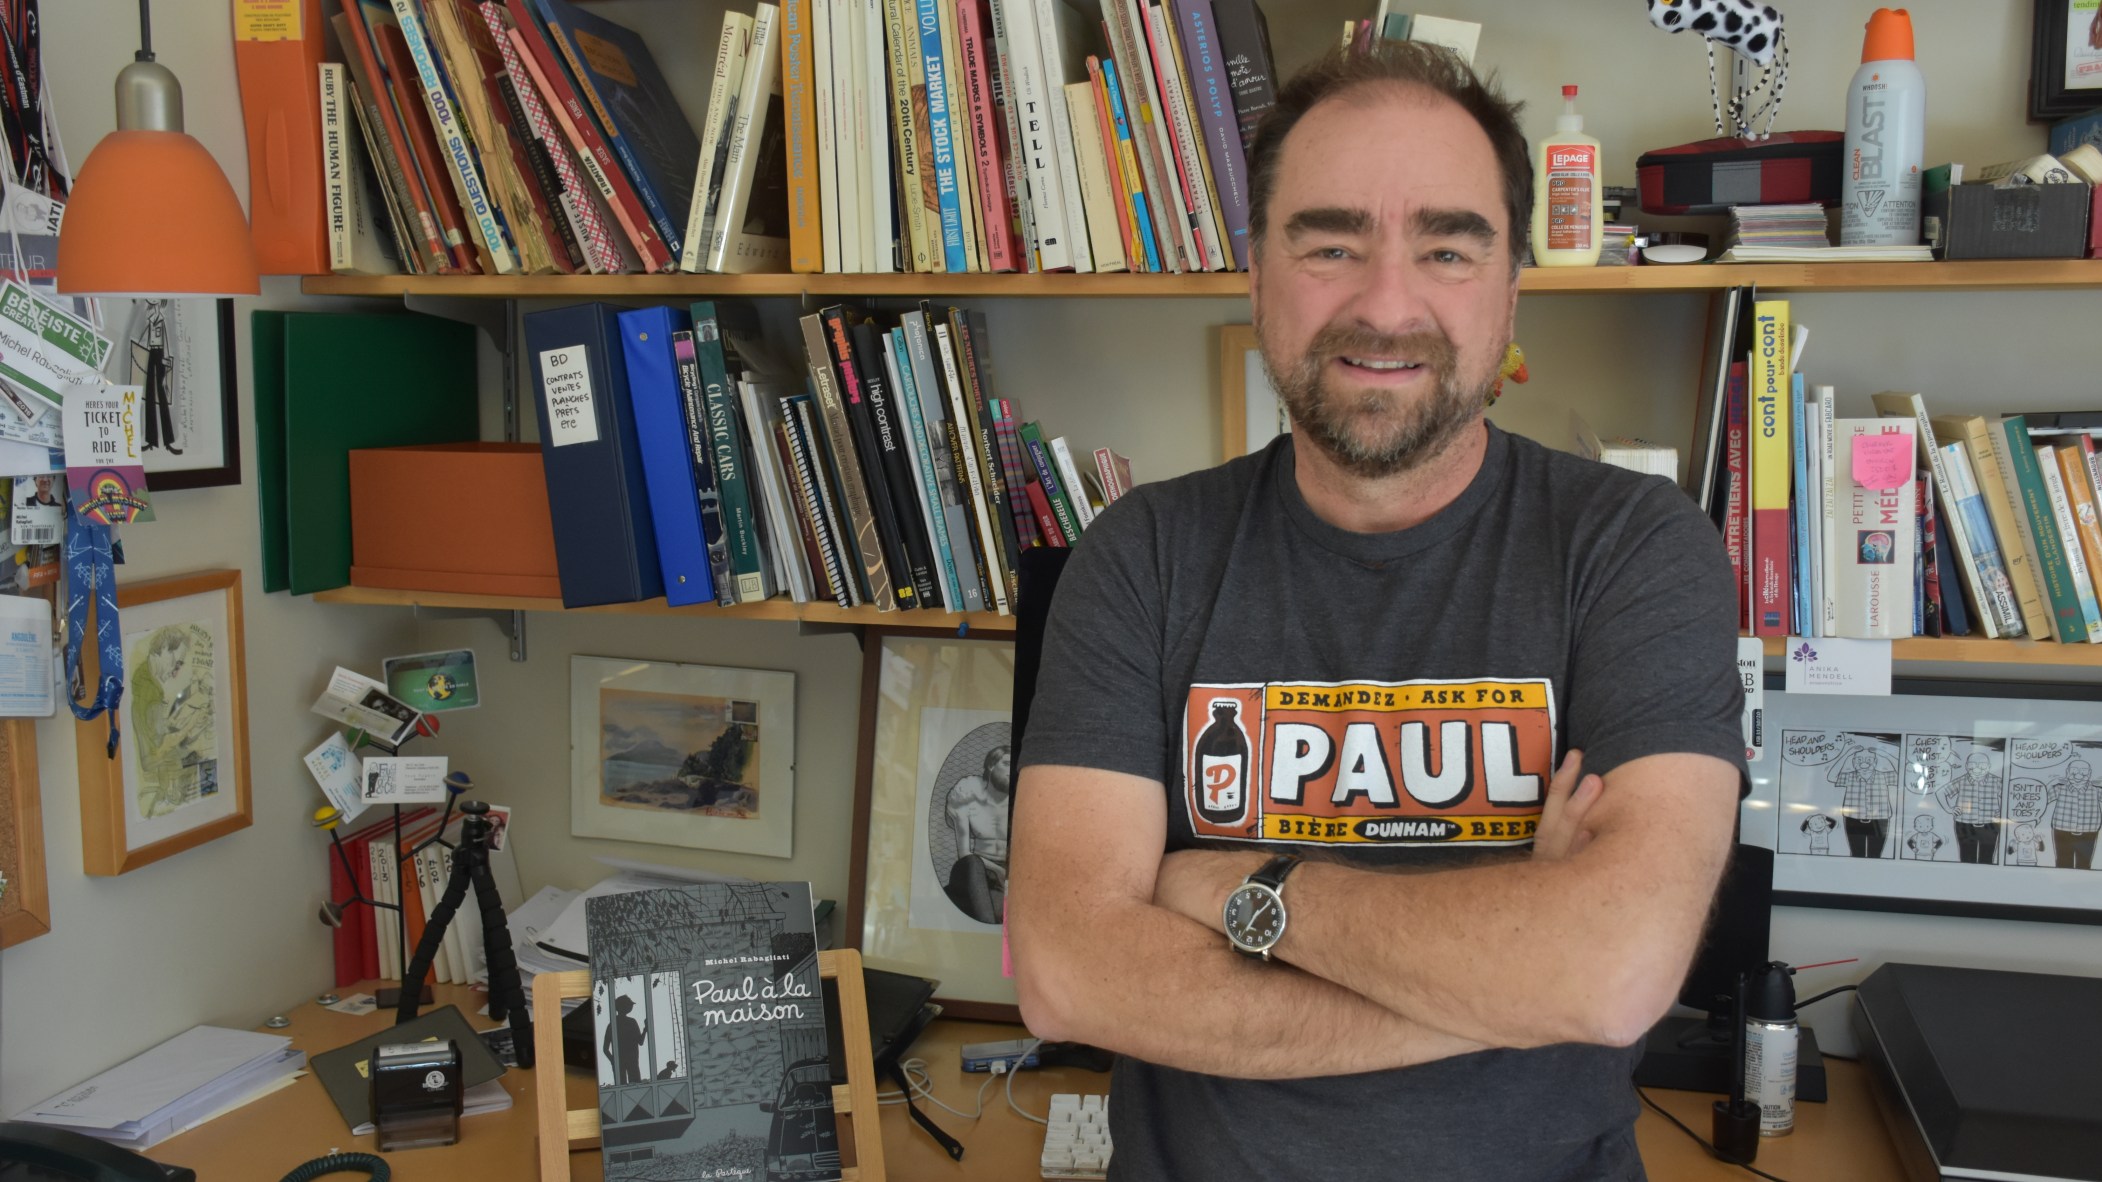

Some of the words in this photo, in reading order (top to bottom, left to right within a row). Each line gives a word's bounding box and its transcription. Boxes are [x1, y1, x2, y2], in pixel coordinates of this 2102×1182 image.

[399, 13, 439, 89] REPONSES
[714, 23, 735, 78] Montréal
[787, 33, 803, 82] Poster
[889, 22, 905, 67] Calendar
[903, 23, 921, 67] ANIMALS
[964, 36, 976, 68] TRADE
[895, 67, 905, 80] of
[1226, 54, 1250, 67] mille
[1231, 65, 1252, 77] mots
[12, 68, 33, 109] d'Eastman
[322, 67, 335, 97] RUBY
[897, 80, 907, 96] the
[923, 52, 946, 113] MARKET
[968, 70, 980, 102] MARKS
[1231, 74, 1266, 88] d'amour
[325, 99, 338, 126] THE
[429, 89, 453, 126] 1000
[898, 98, 912, 127] 20th
[1164, 77, 1188, 151] MÉTROPOLITAIN
[1191, 11, 1213, 73] ASTERIOS
[1206, 77, 1223, 118] POLYP
[1218, 126, 1228, 149] DAVID
[1223, 151, 1241, 207] MAZZUCCHELLI
[732, 116, 748, 138] The
[788, 82, 808, 178] Renaissance
[931, 116, 952, 163] STOCK
[974, 112, 988, 157] SYMBOLS
[1026, 101, 1046, 169] TELL
[1861, 96, 1885, 180] BLAST
[326, 129, 341, 179] HUMAN
[726, 136, 745, 165] Main
[900, 127, 917, 176] Century
[446, 134, 489, 217] QUESTIONS
[937, 164, 955, 194] THE
[1006, 163, 1017, 194] QUÉBEC
[1183, 154, 1199, 200] FANTASME
[330, 183, 345, 232] FIGURE
[1010, 196, 1019, 219] 2007
[1195, 204, 1203, 215] LE
[480, 216, 501, 249] 1000
[570, 212, 592, 242] MUSÉE
[656, 216, 675, 241] HMH
[585, 243, 603, 269] GUIDE
[6, 290, 82, 345] BÉDÉISTE
[959, 323, 970, 339] LES
[827, 316, 852, 361] graphis
[908, 318, 928, 361] photonica
[550, 354, 568, 367] BD
[961, 340, 978, 377] NATURES
[546, 370, 584, 385] CONTRATS
[551, 382, 581, 394] VENTES
[681, 364, 691, 388] Bicycle
[816, 366, 836, 409] Letraset
[838, 359, 864, 404] posters
[900, 364, 920, 419] CARTOUCHES
[1767, 360, 1778, 393] pour
[551, 393, 590, 407] PLANCHES
[684, 388, 698, 429] Maintenance
[867, 383, 886, 408] high
[969, 378, 985, 412] MORTES
[1824, 397, 1832, 422] FABCARO
[84, 411, 121, 428] TICKET
[122, 391, 136, 458] MICHEL
[704, 382, 731, 442] CLASSIC
[98, 426, 109, 438] TO
[691, 429, 700, 443] And
[873, 406, 896, 452] contrast
[912, 418, 924, 439] AND
[1917, 410, 1935, 447] typographie
[92, 441, 118, 453] RIDE
[693, 443, 703, 464] Repair
[979, 427, 995, 462] Norbert
[1029, 443, 1048, 468] conjuguer
[1727, 428, 1742, 469] AVEC
[1928, 446, 1936, 454] la
[1930, 453, 1939, 462] de
[715, 443, 736, 481] CARS
[917, 439, 935, 488] DECORATIVE
[1039, 468, 1048, 476] de
[985, 462, 1004, 505] Schneider
[1042, 476, 1054, 489] L'Art
[1939, 483, 1948, 493] Le
[928, 487, 941, 515] SMALL
[1851, 492, 1864, 524] PETIT
[2027, 487, 2045, 537] MOUVEMENT
[734, 507, 744, 527] Martin
[934, 515, 948, 546] FRAMES
[1048, 496, 1080, 543] BESCHERELLE
[1724, 471, 1743, 565] ENTRETIENS
[737, 529, 749, 555] Buckley
[2040, 538, 2051, 558] D'UN
[2042, 513, 2061, 566] CLANDESTIN
[2064, 532, 2074, 542] Le
[968, 588, 978, 598] 16
[2046, 559, 2062, 598] HISTOIRE
[1869, 571, 1879, 626] LAROUSSE
[1995, 589, 2012, 624] ASSIMIL
[1279, 691, 1395, 708] DEMANDEZ
[1421, 689, 1466, 704] ASK
[1476, 689, 1524, 703] FOR
[1785, 735, 1807, 744] HEAD
[1807, 735, 1826, 744] AND
[1788, 743, 1835, 756] SHOULDERS
[1915, 738, 1941, 746] CHEST
[2015, 743, 2038, 751] HEAD
[2040, 742, 2057, 750] AND
[2015, 749, 2062, 759] SHOULDERS
[1270, 720, 1549, 808] PAUL
[2035, 784, 2043, 792] IT
[2016, 801, 2034, 809] AND
[1279, 817, 1348, 838] BIÈRE
[1471, 821, 1537, 836] BEER
[379, 848, 389, 882] 2013
[704, 957, 738, 966] Michel
[740, 954, 790, 963] Rabagliati
[692, 976, 758, 1005] Paul
[761, 978, 778, 998] à
[782, 973, 812, 998] la
[703, 1003, 804, 1026] maison
[702, 1170, 713, 1178] la
[716, 1167, 751, 1178] Pastèque
